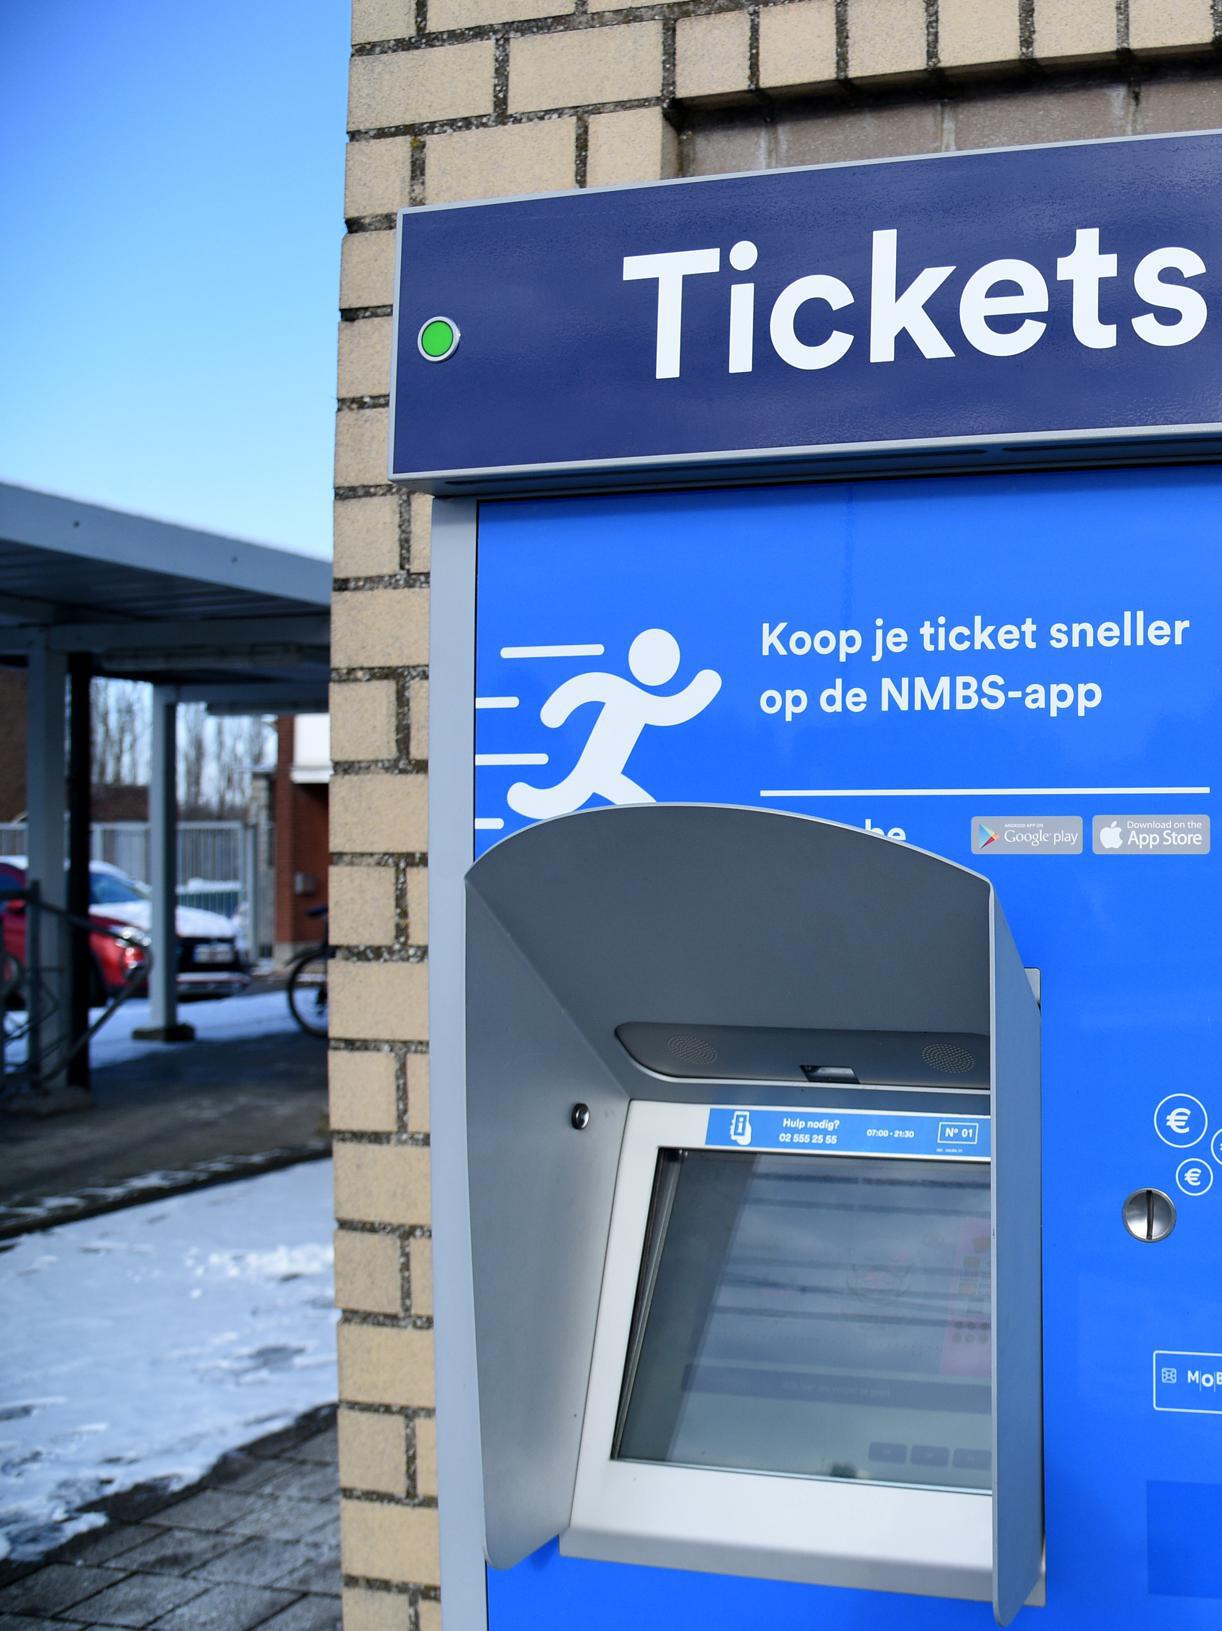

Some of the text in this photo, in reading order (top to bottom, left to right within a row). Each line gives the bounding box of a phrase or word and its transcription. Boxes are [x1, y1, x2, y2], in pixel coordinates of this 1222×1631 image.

[622, 227, 1208, 380] Tickets
[762, 610, 1190, 663] Koop je ticket sneller
[759, 674, 1103, 722] op de NMBS-app
[1127, 820, 1172, 829] Download
[1187, 820, 1202, 829] the
[1004, 829, 1079, 847] Google play
[1127, 829, 1202, 849] App Store
[783, 1118, 840, 1131] Hulp nodig?
[779, 1133, 838, 1144] 02 555 25 55
[866, 1128, 889, 1137] 07:00
[894, 1129, 915, 1138] 21:30
[961, 1128, 973, 1138] 01
